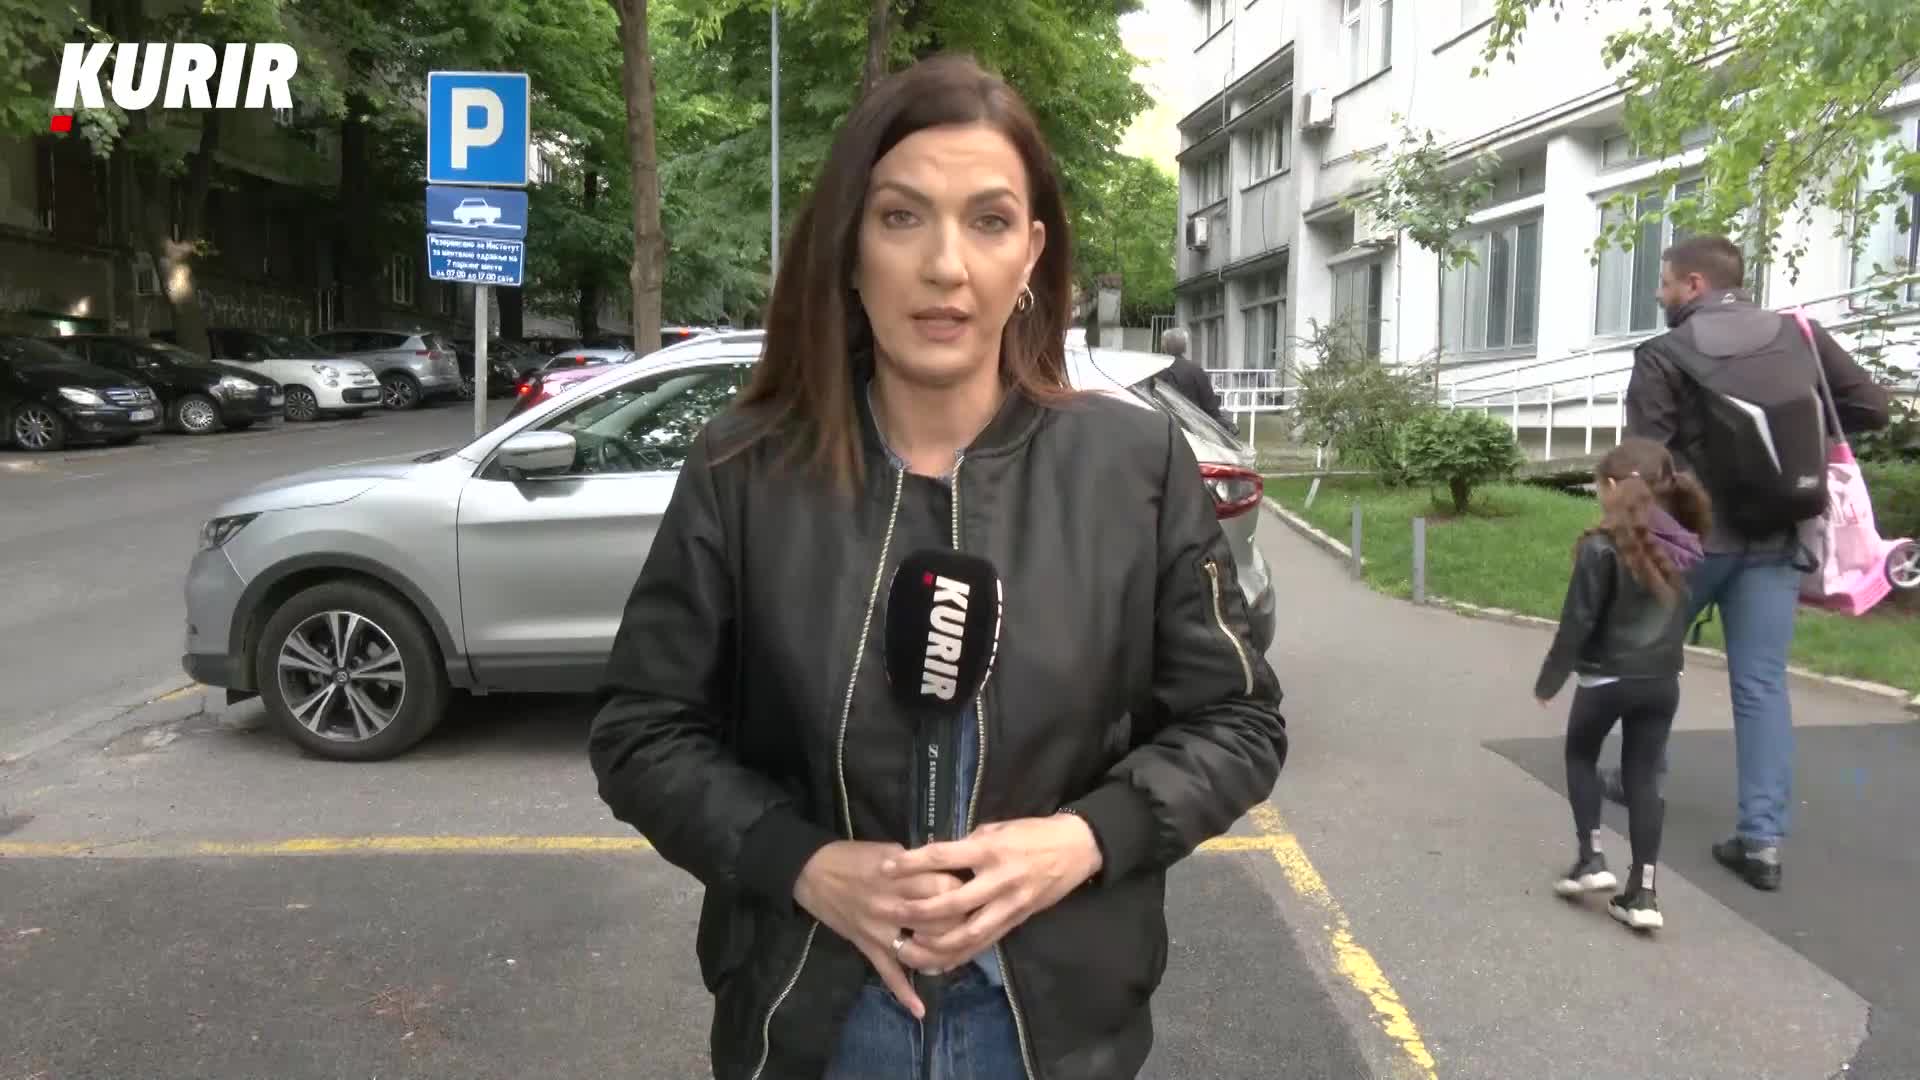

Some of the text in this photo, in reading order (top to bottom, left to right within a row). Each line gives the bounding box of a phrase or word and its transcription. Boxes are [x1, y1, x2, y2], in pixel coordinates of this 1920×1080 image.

[450, 87, 504, 169] P
[486, 242, 520, 253] Институт
[921, 576, 970, 701] KURIR
[929, 761, 937, 827] SENNHEISER
